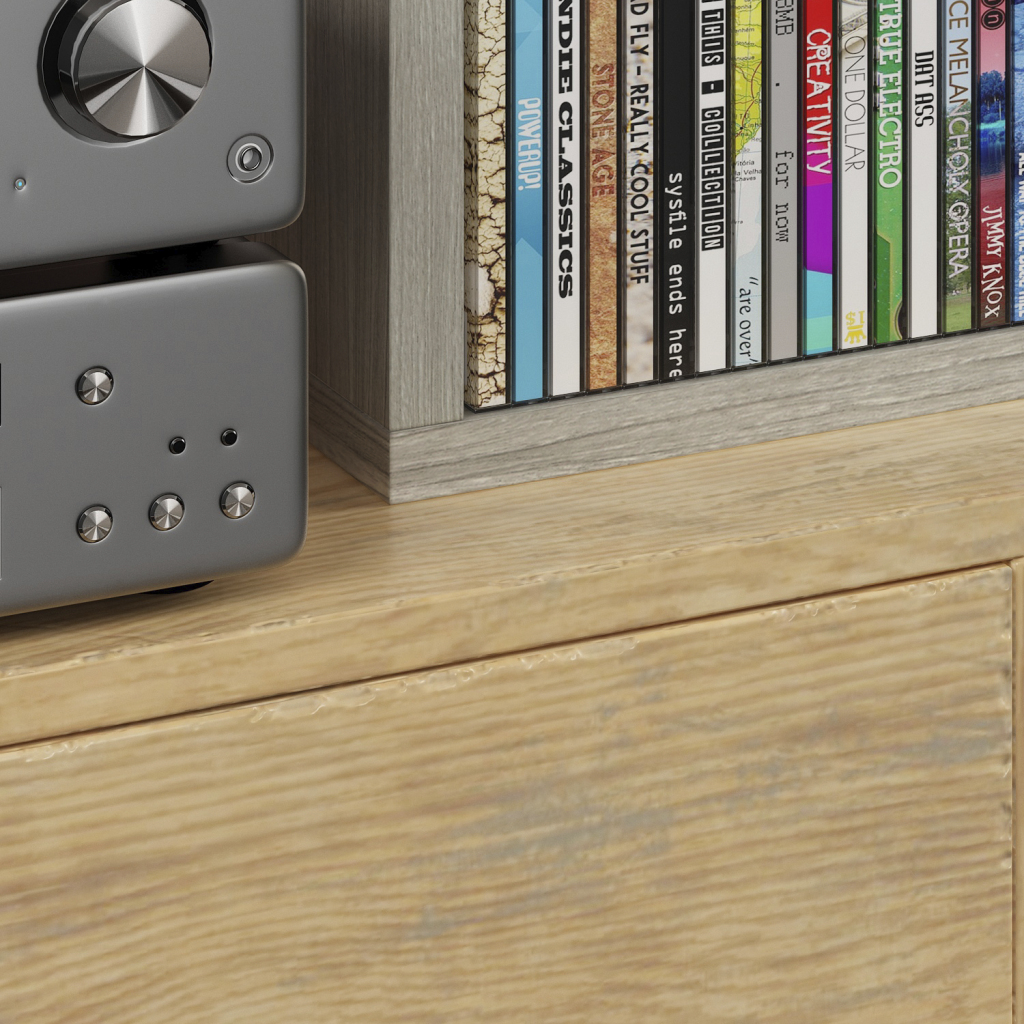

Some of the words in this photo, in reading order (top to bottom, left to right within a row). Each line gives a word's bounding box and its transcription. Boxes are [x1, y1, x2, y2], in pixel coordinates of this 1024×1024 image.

[630, 24, 649, 56] FLY
[703, 10, 722, 66] THIS
[845, 36, 866, 84] ONE
[915, 50, 934, 87] DAT
[592, 63, 614, 137] STONE
[630, 85, 649, 153] REALLY
[807, 28, 832, 174] CREATIVITY
[915, 93, 934, 128] ASS
[949, 39, 969, 193] MELANCHOLY
[518, 97, 541, 191] POWERUP!
[845, 90, 866, 172] DOLLAR
[879, 72, 902, 188] ELECTRO
[592, 148, 615, 196] AGE
[630, 163, 649, 221] COOL
[703, 108, 722, 250] COLLECTION
[775, 150, 794, 189] for
[558, 102, 573, 298] CLASSICS
[665, 172, 687, 249] sysfile
[775, 202, 788, 243] now
[630, 229, 649, 284] STUFF
[949, 201, 969, 278] OPERA
[981, 205, 1005, 256] JIMMY
[668, 264, 686, 315] ends
[981, 263, 1005, 318] KNOX
[668, 328, 687, 377] here
